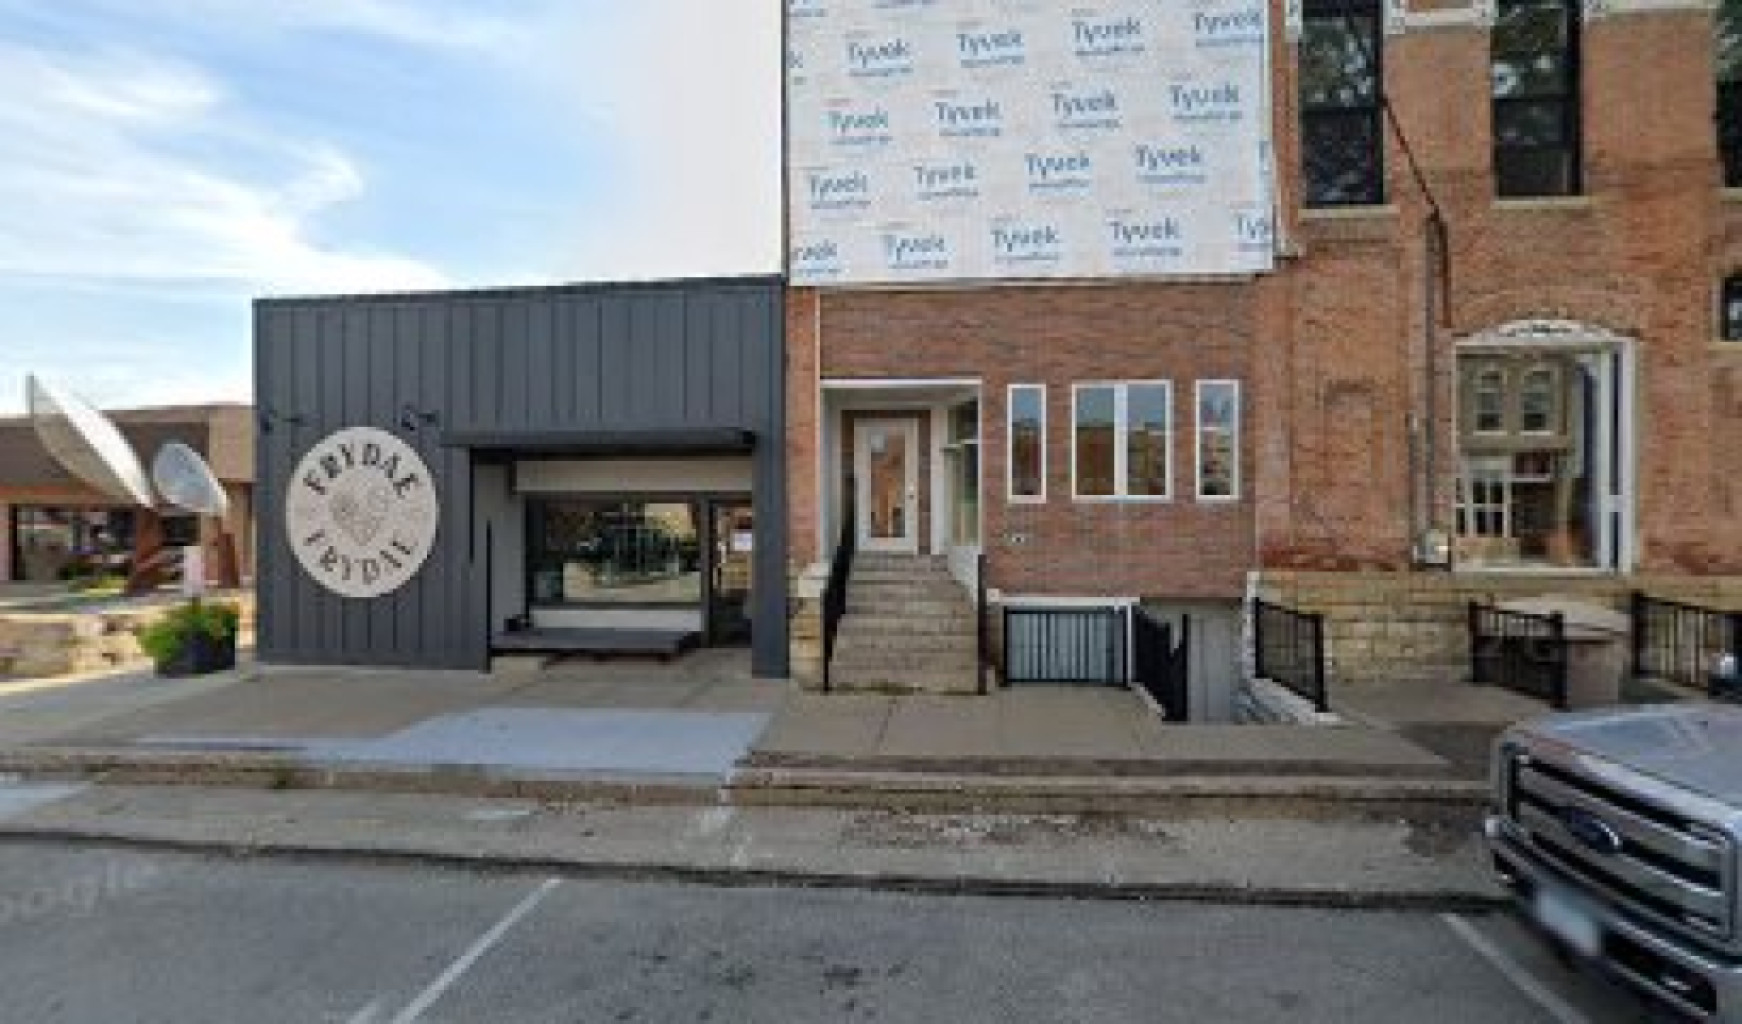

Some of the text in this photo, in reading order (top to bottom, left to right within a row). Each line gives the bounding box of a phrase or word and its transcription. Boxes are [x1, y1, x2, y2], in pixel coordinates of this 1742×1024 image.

[956, 29, 1024, 56] Tyvek
[1071, 16, 1141, 44] Tyvek
[849, 38, 911, 68] Tyvek
[1050, 90, 1117, 117] Tyvek
[1170, 82, 1240, 111] Tyvek
[1136, 144, 1202, 171] Tyvek
[990, 225, 1060, 252] Tyvek
[1108, 217, 1180, 243] Tyvek
[302, 442, 420, 499] FRYDAE
